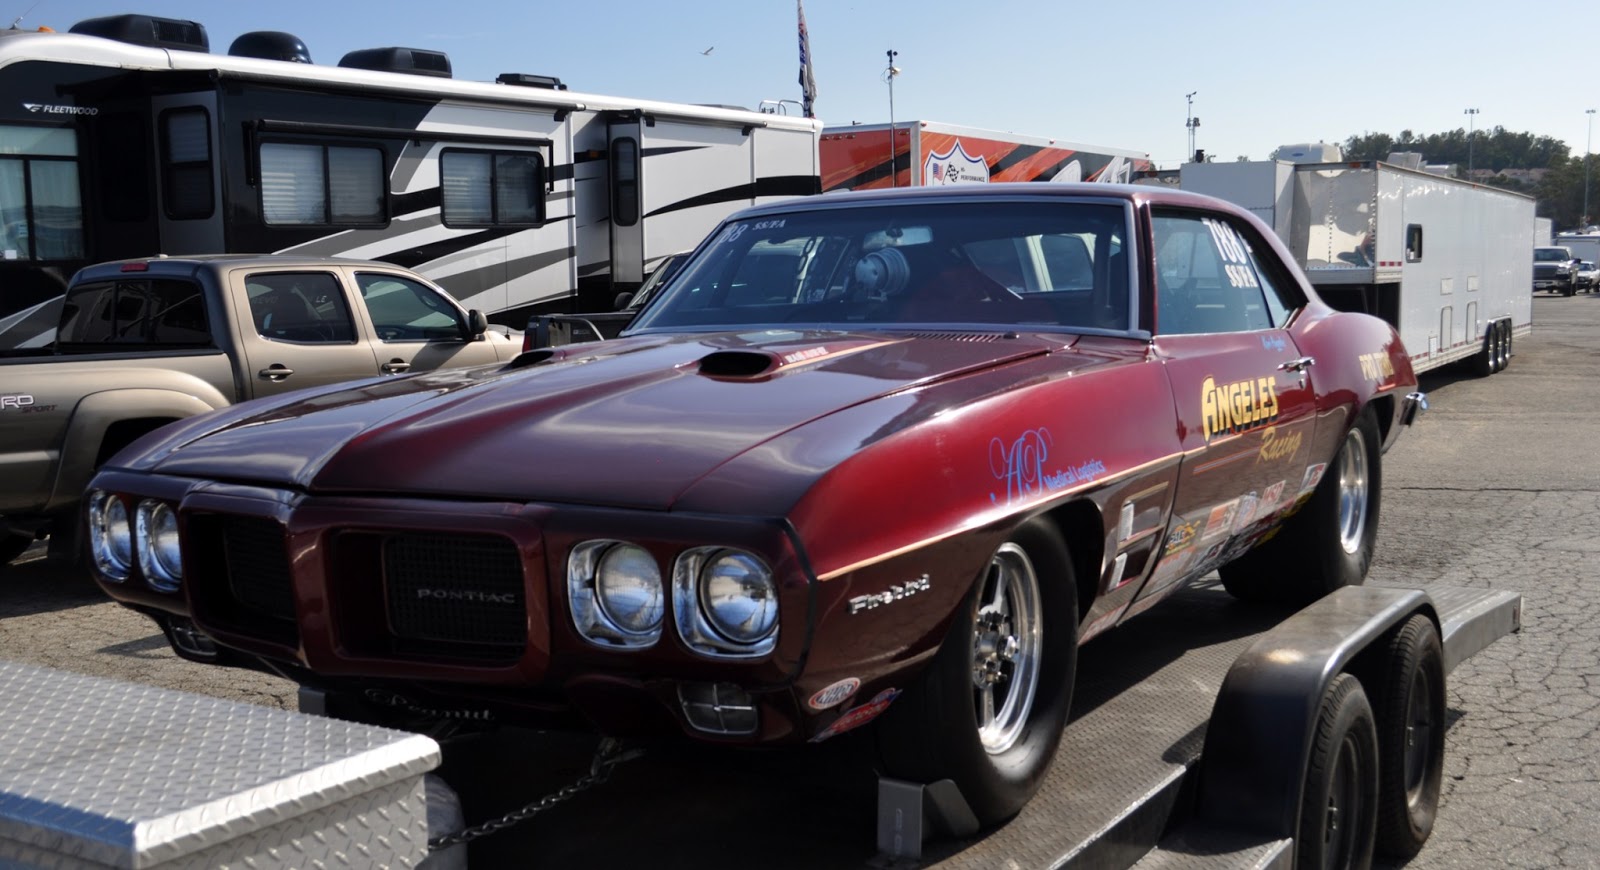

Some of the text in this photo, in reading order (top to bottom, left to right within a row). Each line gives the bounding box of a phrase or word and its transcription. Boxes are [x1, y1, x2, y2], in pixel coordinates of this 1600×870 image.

[43, 104, 99, 116] FLEETWOOD
[960, 174, 985, 182] PERFORMANCE
[1202, 375, 1278, 443] ANGELES
[1256, 426, 1303, 464] Racing
[1043, 466, 1078, 491] Medical
[417, 588, 515, 603] PONTIAC
[849, 573, 930, 614] Firebird
